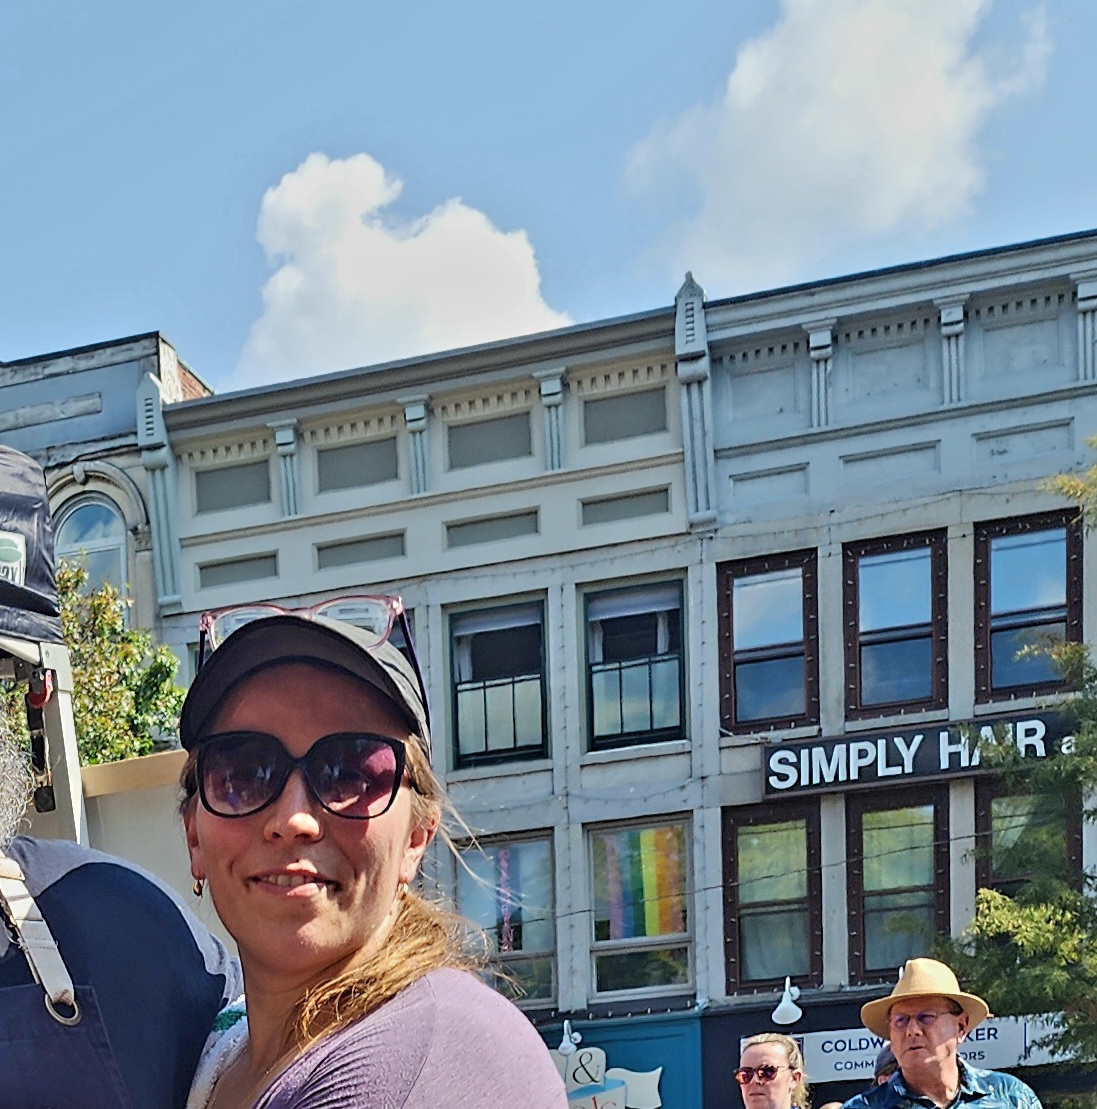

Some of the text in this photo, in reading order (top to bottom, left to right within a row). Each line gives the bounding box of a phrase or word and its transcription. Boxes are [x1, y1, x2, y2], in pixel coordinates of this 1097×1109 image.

[768, 734, 924, 790] SIMPLY
[1060, 735, 1076, 755] a
[821, 1027, 998, 1053] COLDW KER
[834, 1050, 986, 1071] COMM ORS
